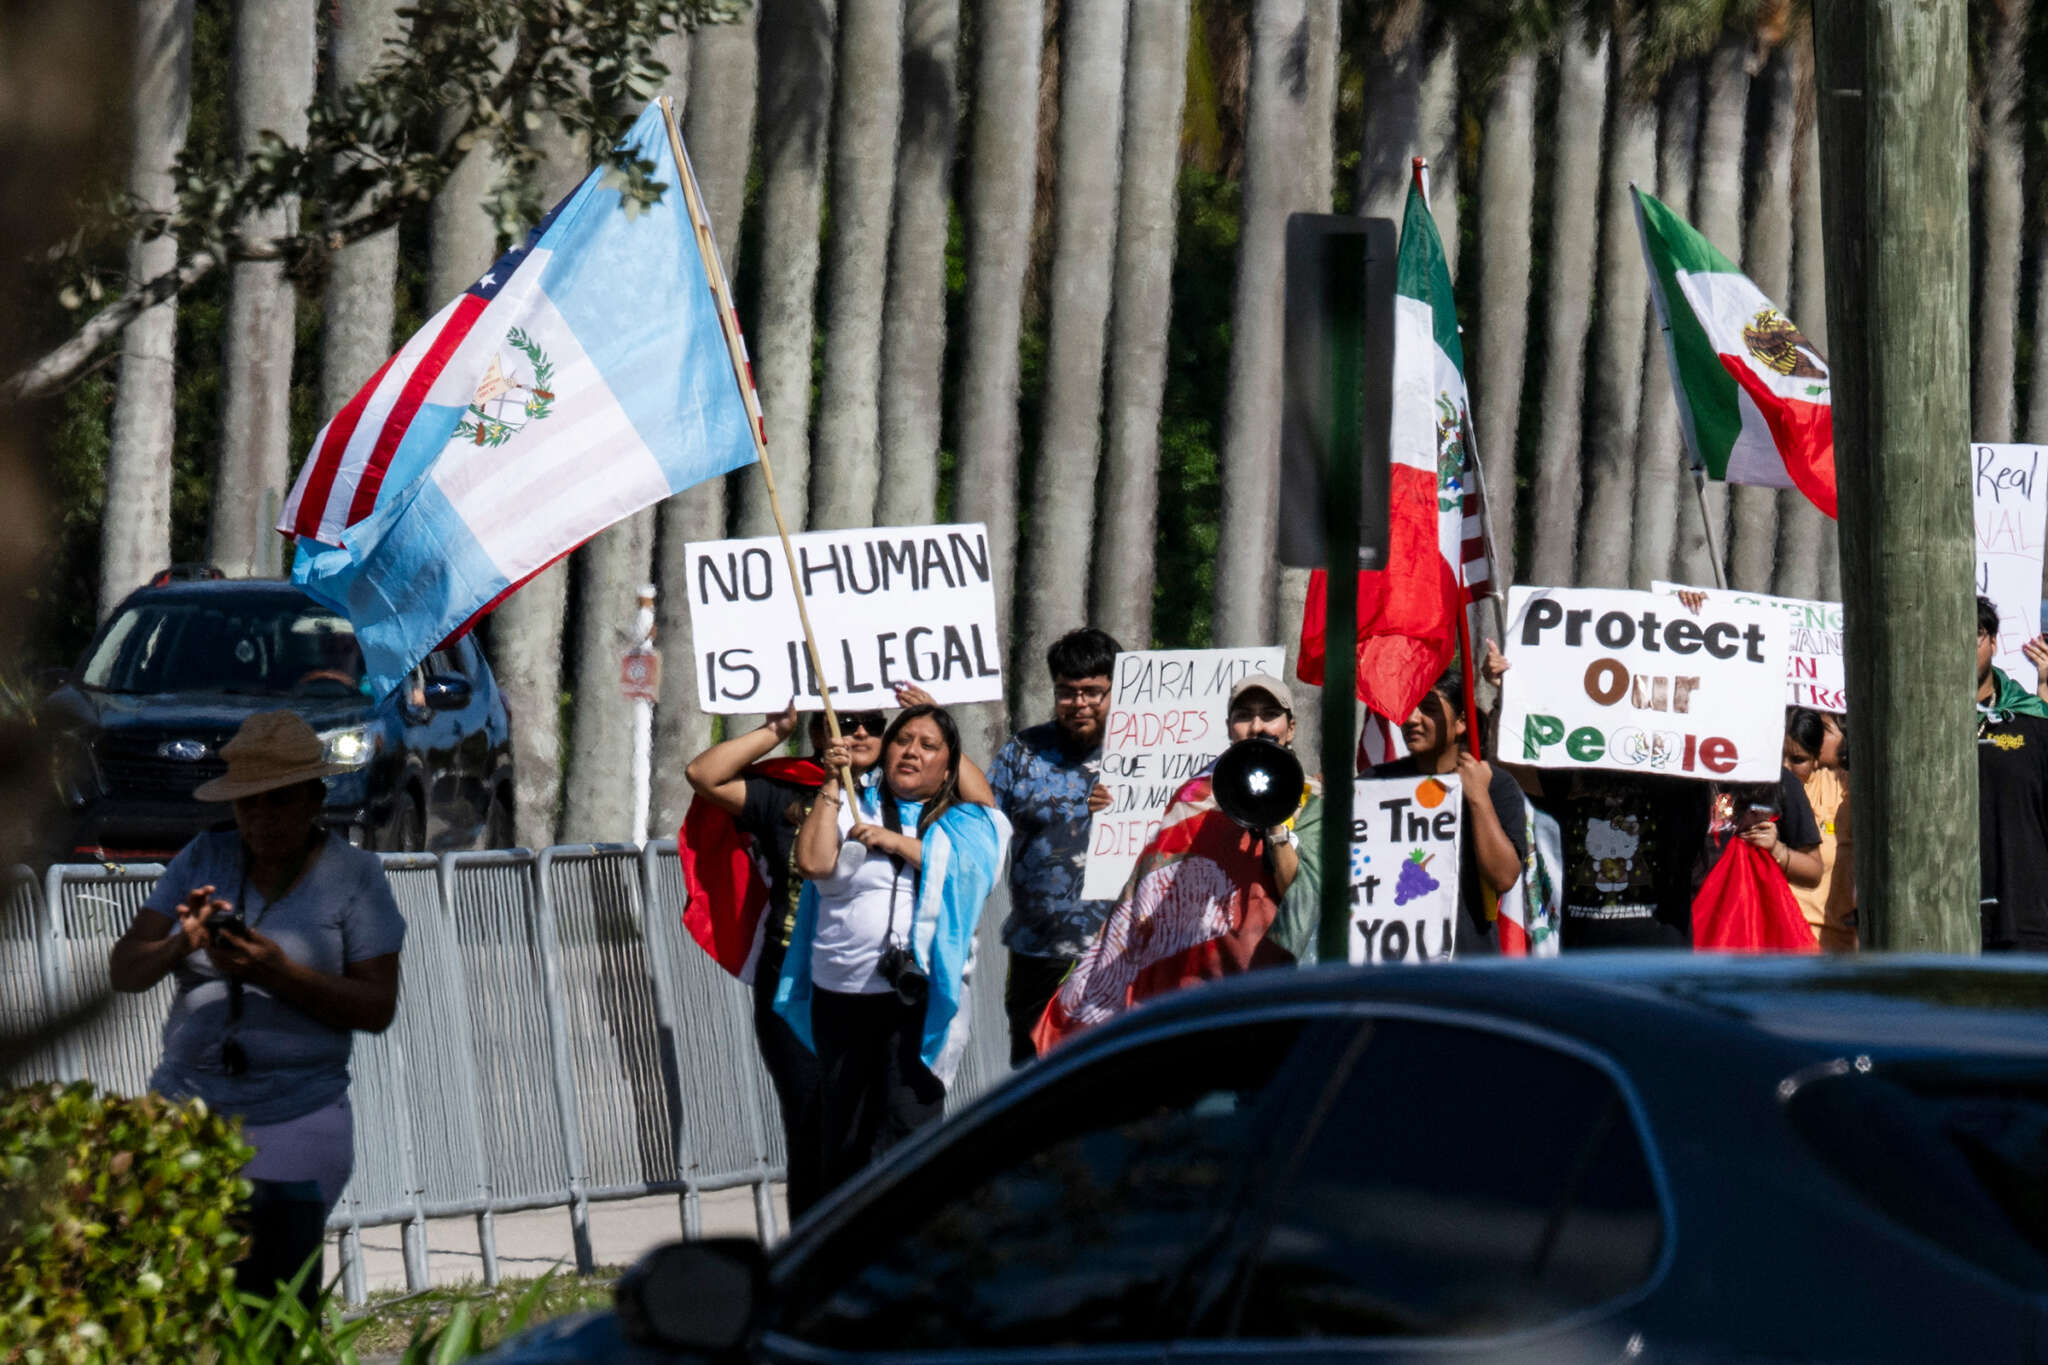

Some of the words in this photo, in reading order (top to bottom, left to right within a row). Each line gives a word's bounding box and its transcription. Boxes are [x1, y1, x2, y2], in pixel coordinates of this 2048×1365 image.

[1977, 446, 2038, 504] Real
[698, 548, 773, 604] NO
[800, 533, 990, 596] HUMAN
[1521, 598, 1765, 664] Protect
[706, 649, 760, 702] IS
[787, 623, 999, 697] ILLEGAL
[1118, 656, 1194, 705] PARA
[1583, 657, 1700, 714] Our
[1107, 710, 1209, 750] PADRES
[1523, 713, 1739, 774] People
[1102, 753, 1152, 778] QUE
